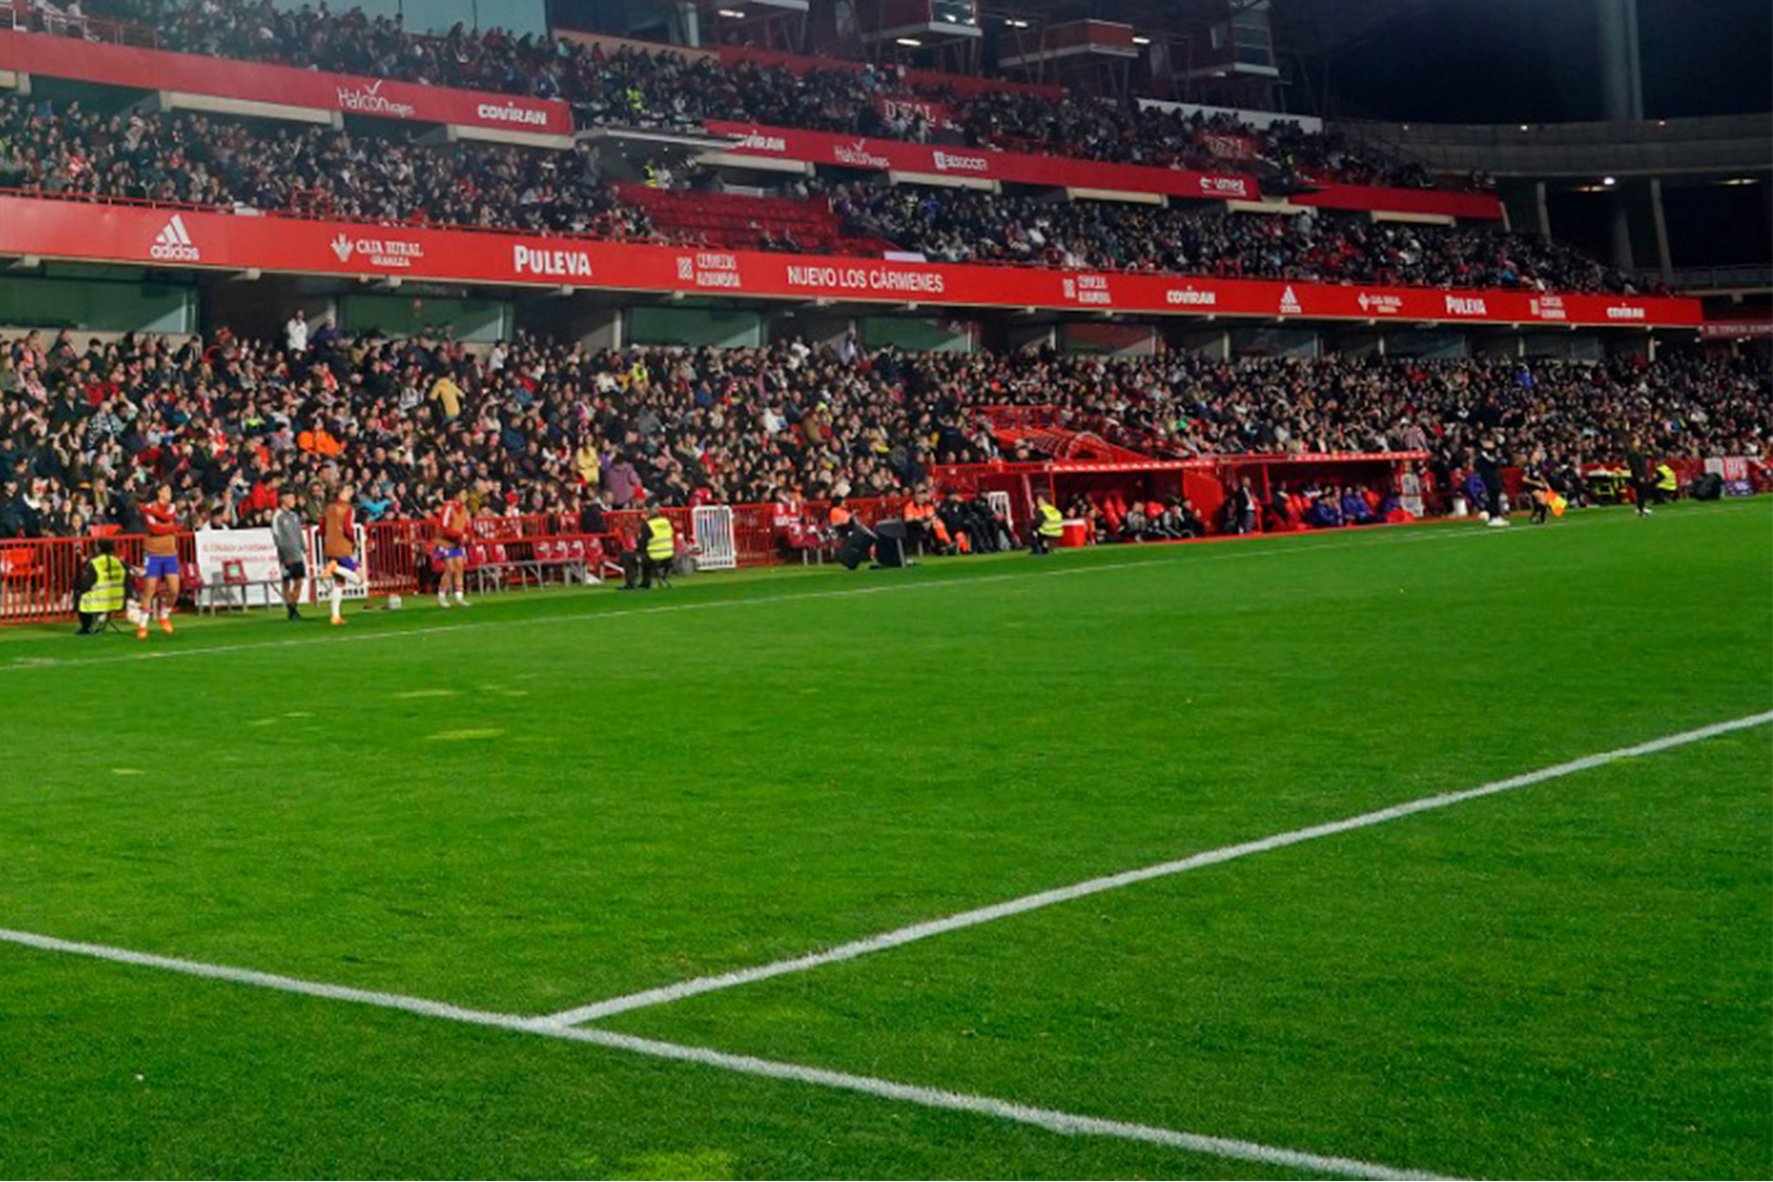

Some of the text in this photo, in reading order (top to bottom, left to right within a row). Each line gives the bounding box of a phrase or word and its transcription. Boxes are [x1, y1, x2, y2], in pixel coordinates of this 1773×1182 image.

[150, 243, 200, 260] adidas
[514, 245, 592, 276] PULEVA
[787, 266, 944, 293] NUEVO LOS CÁRMENES
